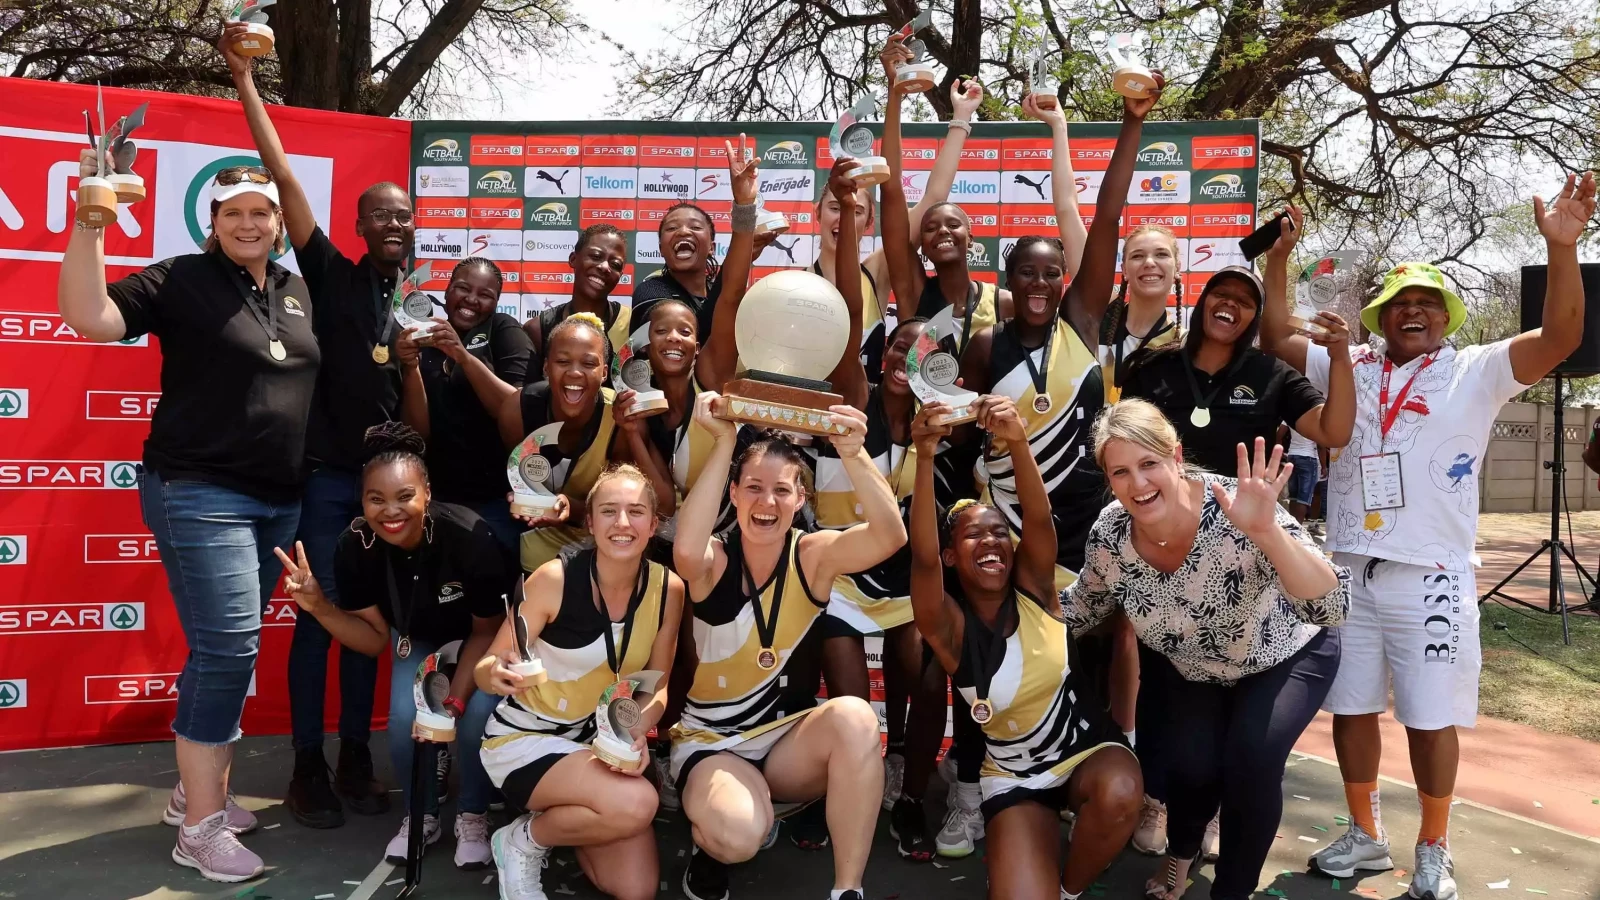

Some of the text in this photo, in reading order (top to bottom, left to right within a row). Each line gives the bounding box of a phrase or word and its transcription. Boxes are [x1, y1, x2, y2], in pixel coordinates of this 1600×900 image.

[423, 149, 462, 158] NETBALL
[763, 151, 808, 161] NETBALL
[1015, 150, 1047, 158] SPAR
[1136, 152, 1183, 162] NETBALL
[1205, 148, 1239, 156] SPAR
[476, 180, 517, 190] NETBALL
[585, 175, 634, 190] Telkom
[759, 175, 811, 194] Energade
[950, 180, 996, 194] elkom
[644, 183, 689, 193] HOLLYWOOD
[1199, 184, 1247, 195] NETBALL
[480, 209, 509, 217] SPAR
[530, 212, 572, 222] NETBALL
[1140, 217, 1173, 225] SPAR
[1203, 216, 1237, 224] SPAR
[420, 243, 462, 253] HOLLYWOOD
[537, 242, 576, 252] Discovery
[637, 249, 662, 258] South
[966, 253, 990, 263] BALL
[1, 318, 80, 338] SPA
[120, 397, 160, 415] SP
[0, 466, 102, 484] SPAR
[118, 540, 158, 557] SP
[264, 605, 297, 620] PA
[0, 609, 101, 629] SPAR
[1423, 574, 1451, 664] BOSS
[1450, 574, 1460, 664] HUGO BOSS
[118, 679, 180, 697] SP
